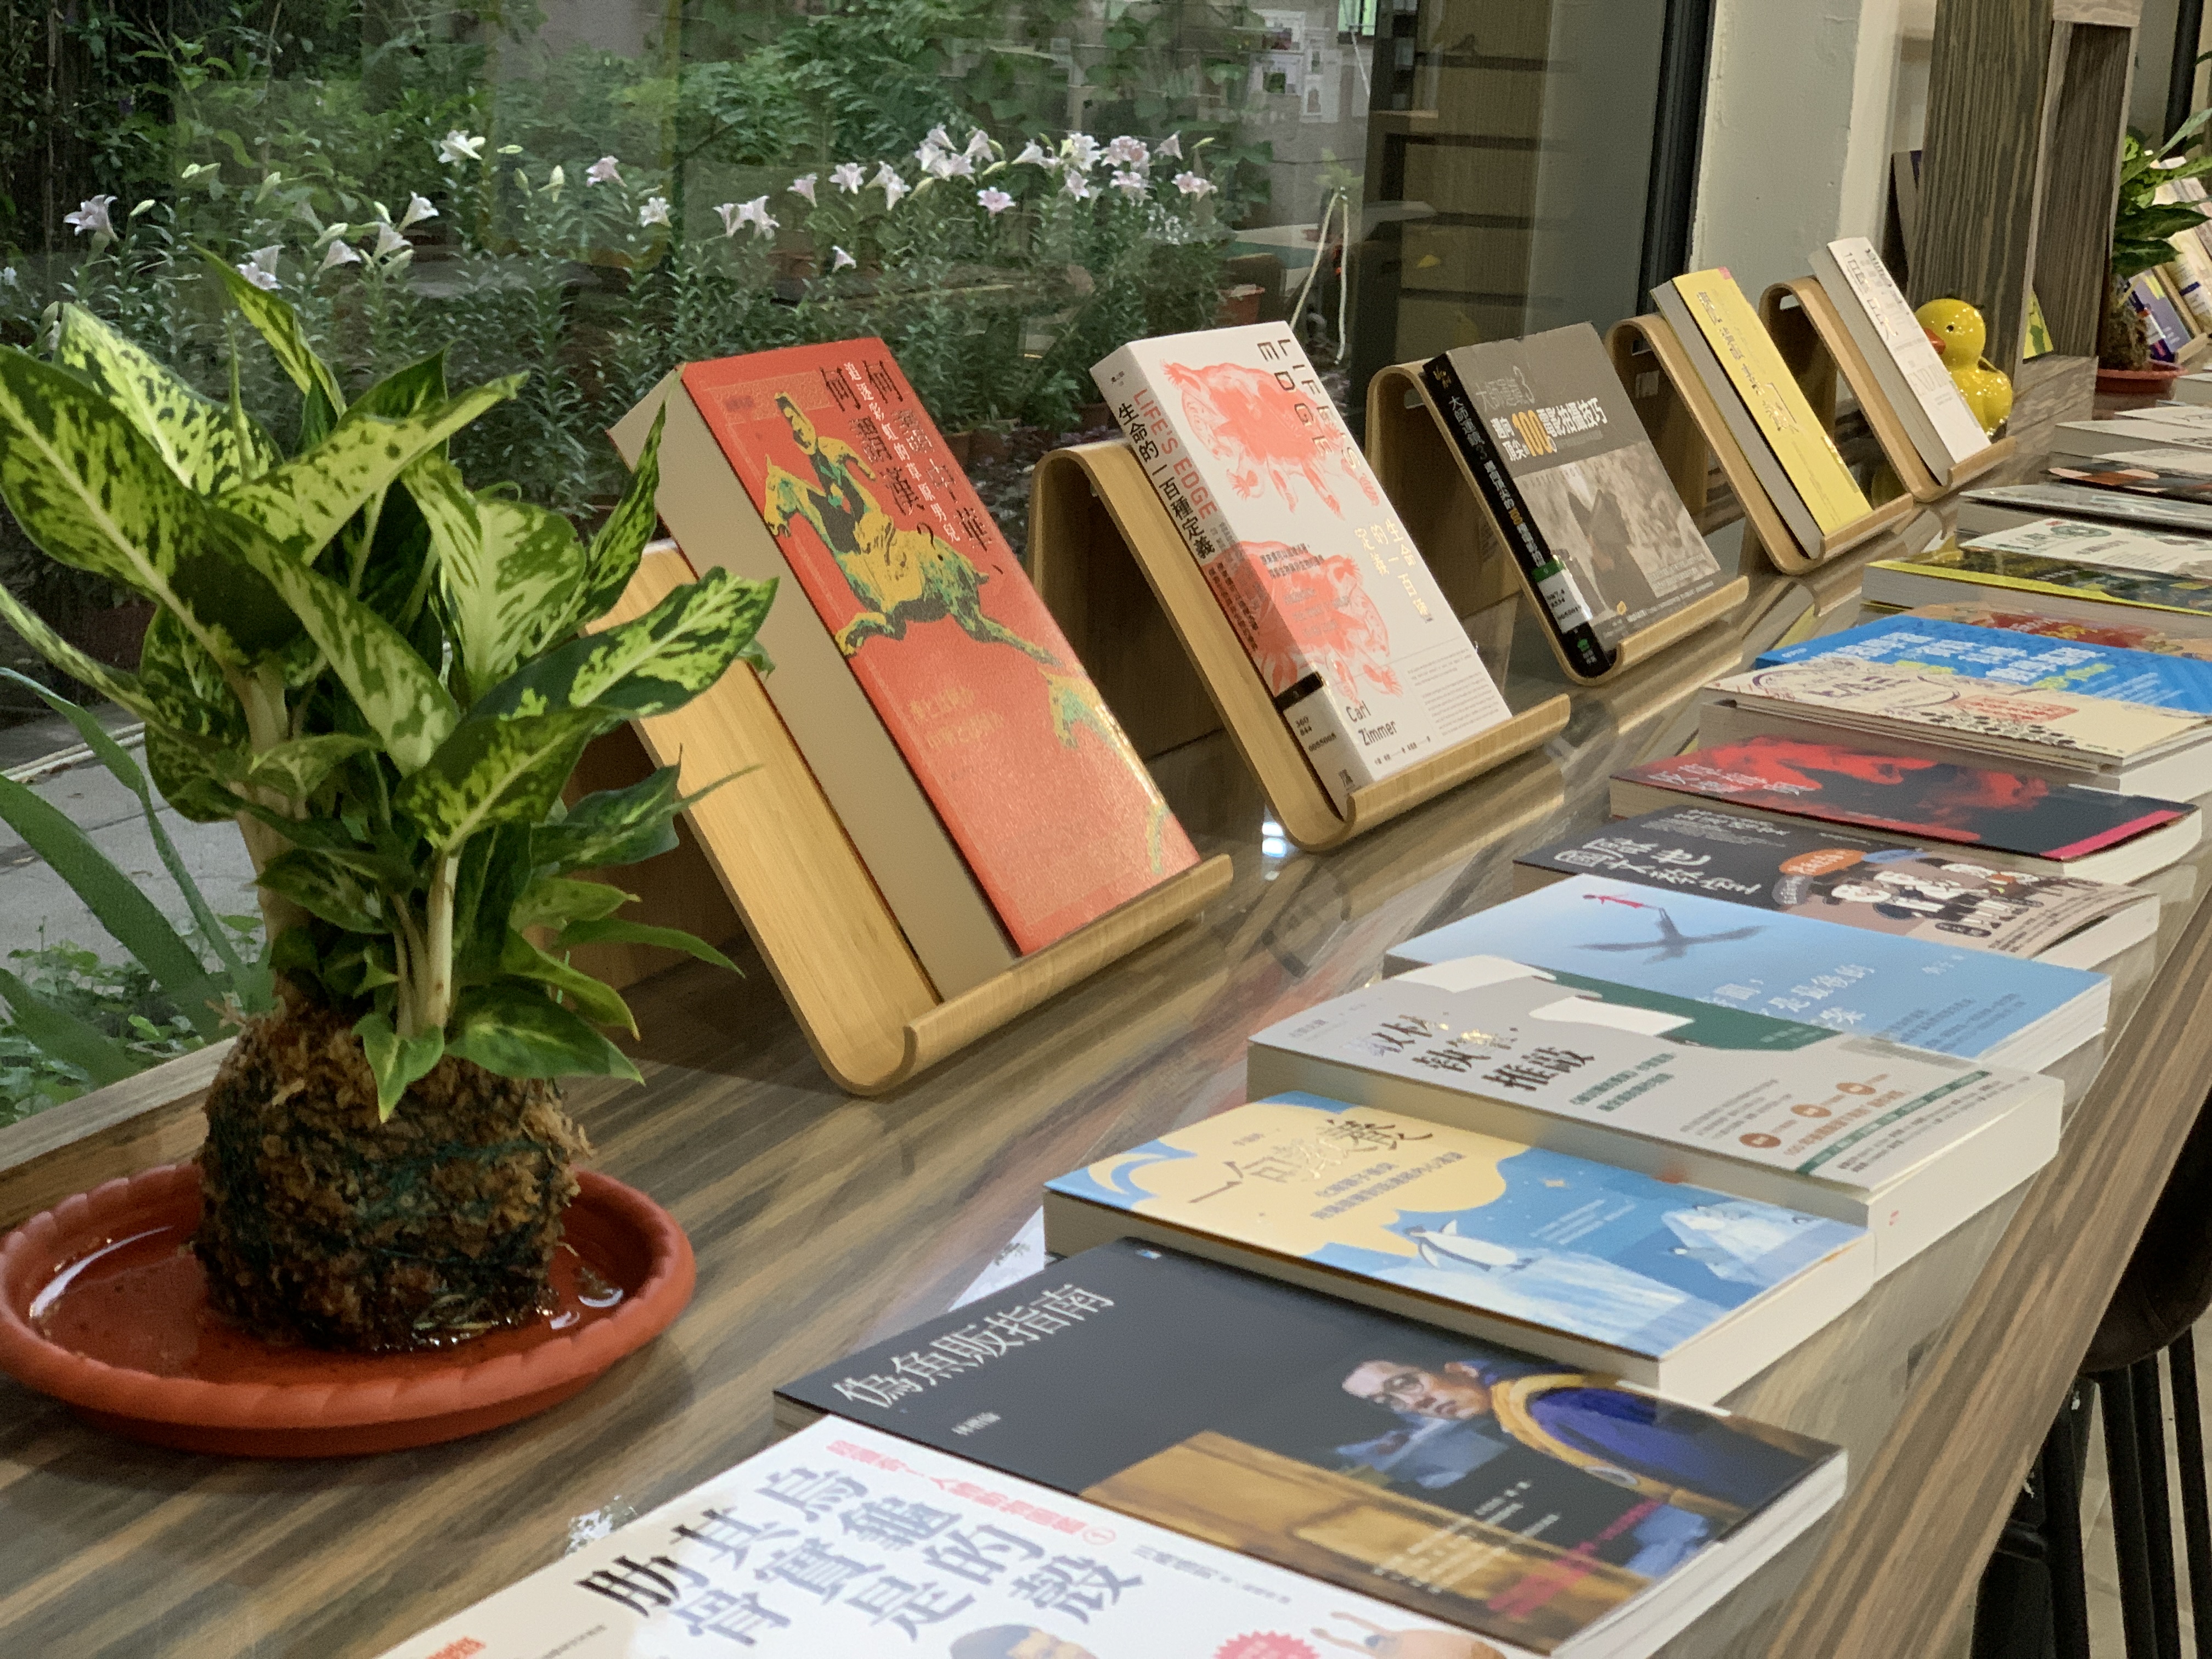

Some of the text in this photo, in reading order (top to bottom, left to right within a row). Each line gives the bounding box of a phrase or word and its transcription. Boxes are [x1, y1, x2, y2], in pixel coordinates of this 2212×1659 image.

[1257, 341, 1333, 457] EDGE
[1512, 410, 1551, 457] 100
[1539, 398, 1607, 436] 電影拍攝技巧
[844, 362, 960, 543] 追逐彩虹的草原男兒
[1118, 402, 1215, 560] 生命的一百種定義
[1133, 389, 1218, 520] LIFE'S EDGE
[1346, 702, 1371, 723] Carl
[1358, 718, 1397, 747] Zimmer
[1553, 849, 1762, 895] 國文教室
[1481, 1046, 1595, 1092] 推敲
[1188, 1119, 1434, 1204] 一句教養
[831, 1283, 1117, 1409] 偽魚販指南
[670, 1506, 977, 1641] 其實是
[755, 1465, 1144, 1624] 烏龜的殼
[574, 1555, 791, 1646] 肋骨
